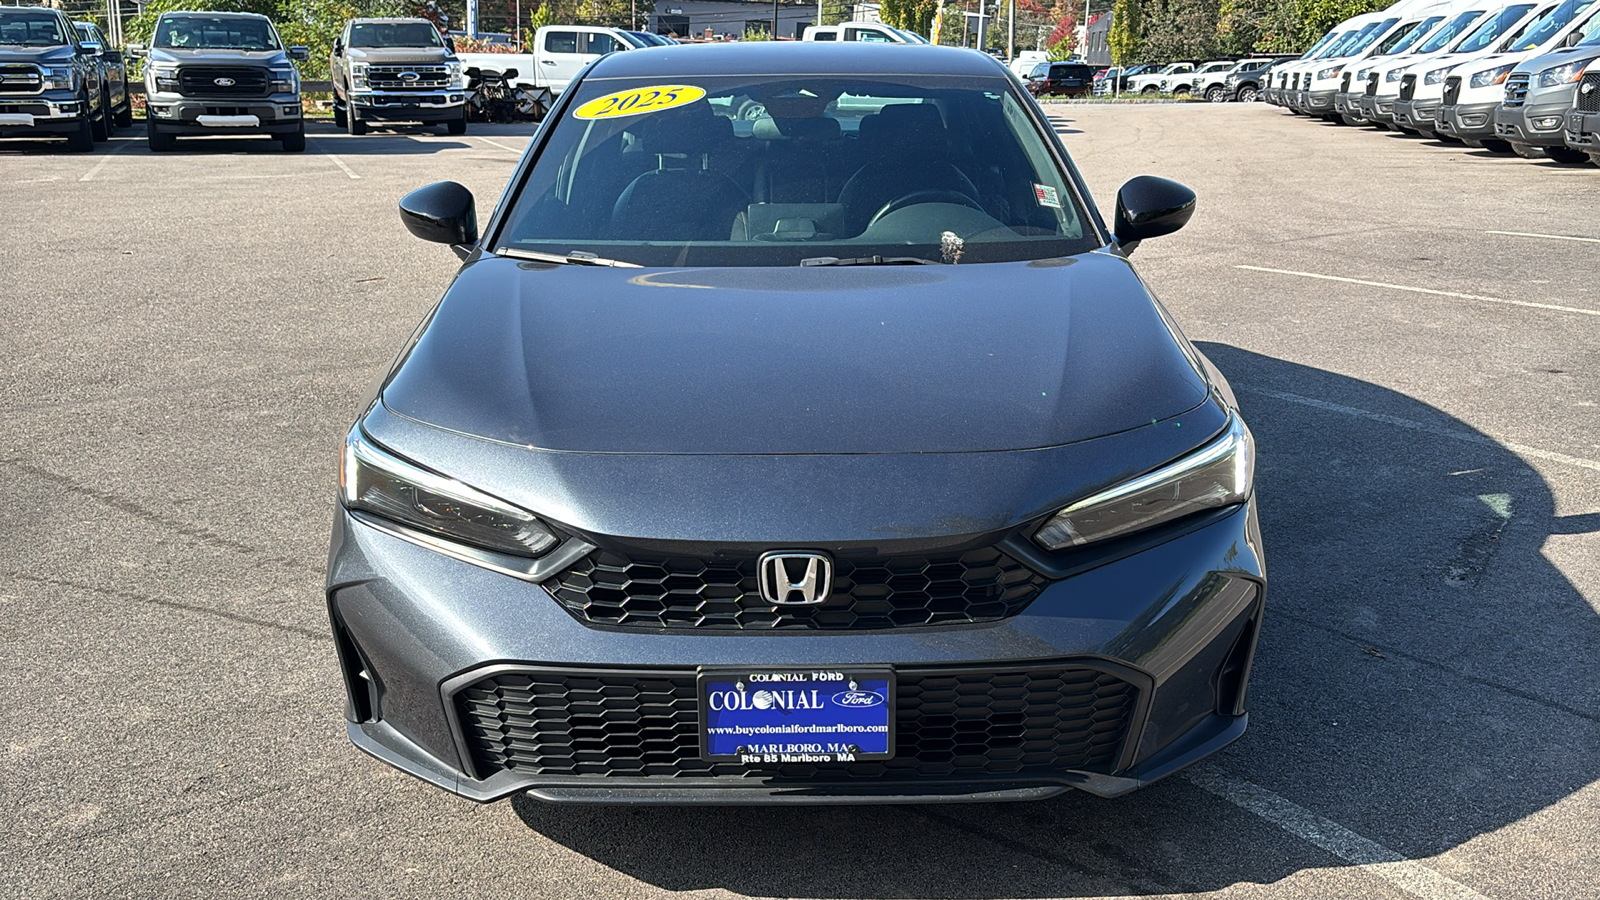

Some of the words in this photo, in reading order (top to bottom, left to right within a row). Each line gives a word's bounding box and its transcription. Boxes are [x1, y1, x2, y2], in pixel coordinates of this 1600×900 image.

[594, 88, 684, 116] 2025
[749, 673, 807, 682] COLONIAL
[812, 671, 844, 681] FORD
[709, 690, 824, 711] COLONIAL
[841, 692, 874, 704] Ford
[707, 723, 888, 736] www.buycolonialfordmarlboro.com
[747, 743, 825, 753] MARLBORO,
[827, 743, 849, 752] MA
[741, 754, 761, 763] Rte
[763, 754, 778, 763] 85
[780, 753, 831, 763] Marlboro
[837, 752, 856, 762] MA
